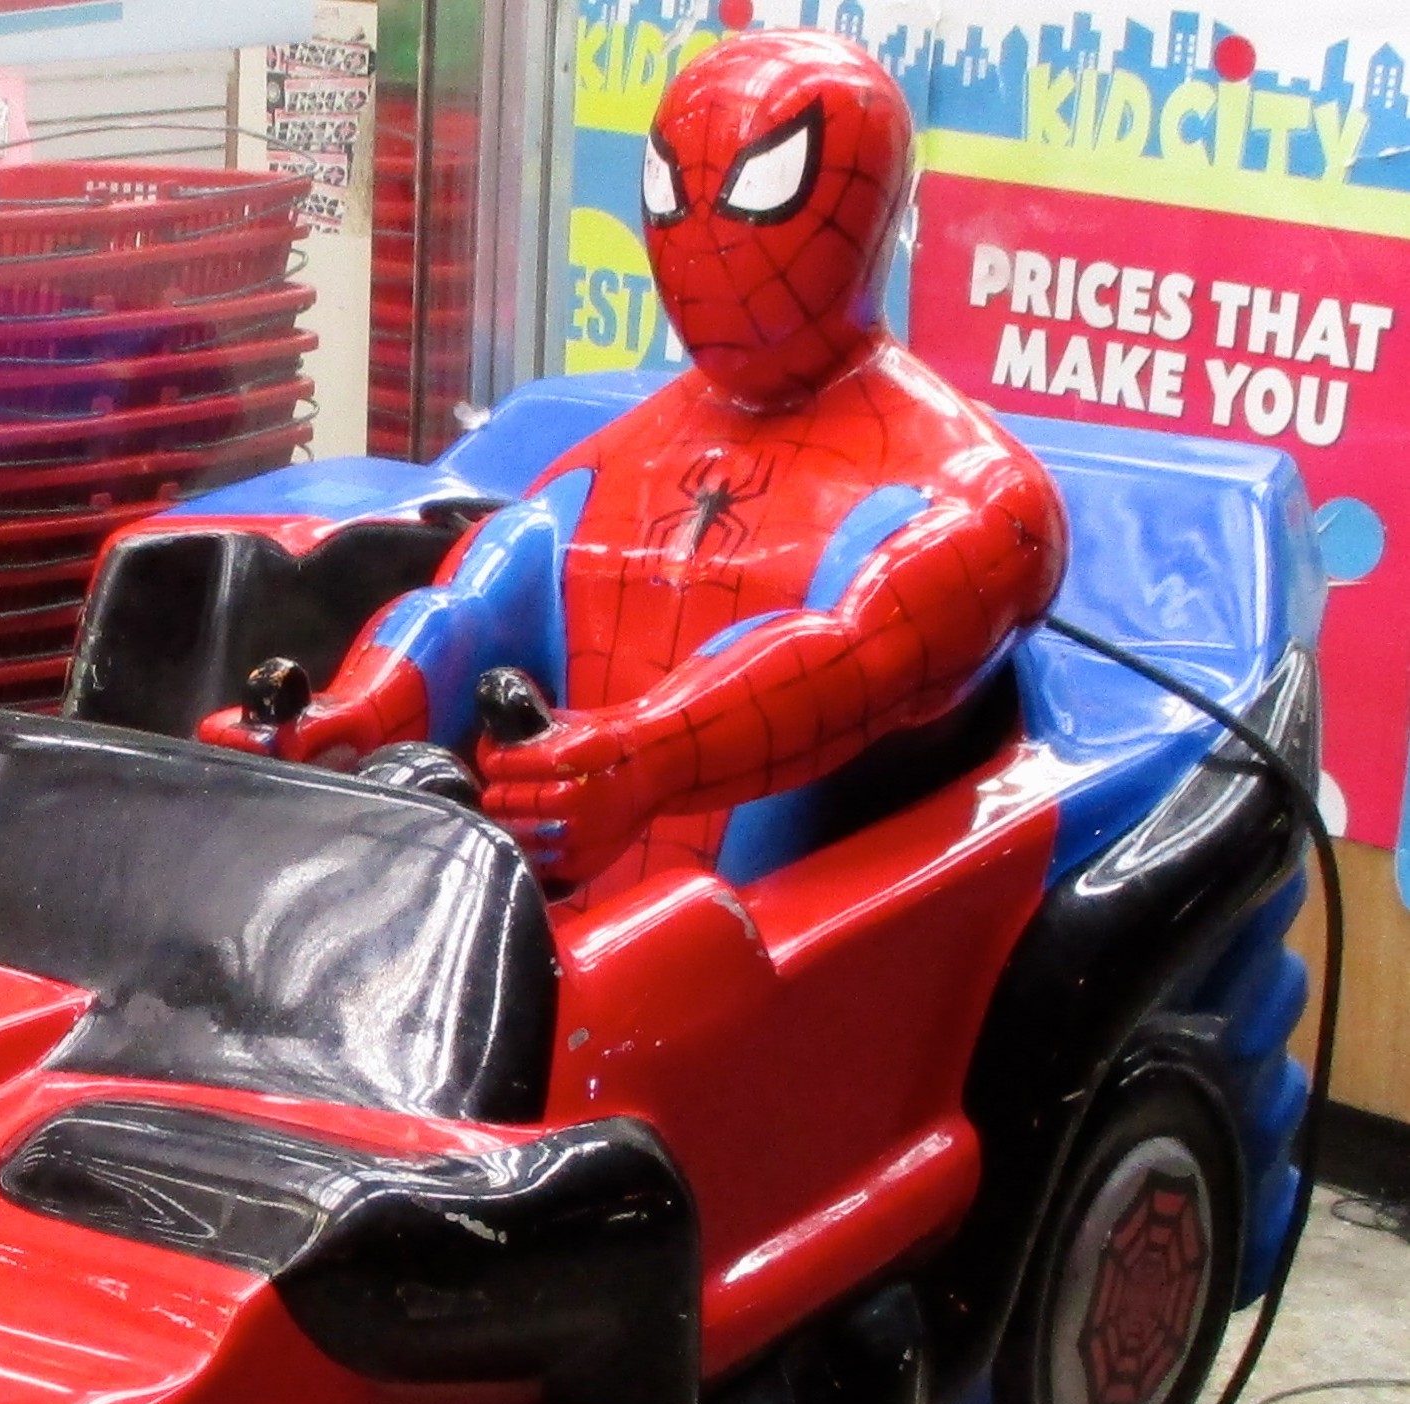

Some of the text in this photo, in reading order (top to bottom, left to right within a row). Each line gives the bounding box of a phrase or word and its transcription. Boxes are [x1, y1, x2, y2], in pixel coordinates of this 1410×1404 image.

[969, 244, 1394, 372] PRICES THAT
[992, 324, 1349, 447] MAKE YOU
